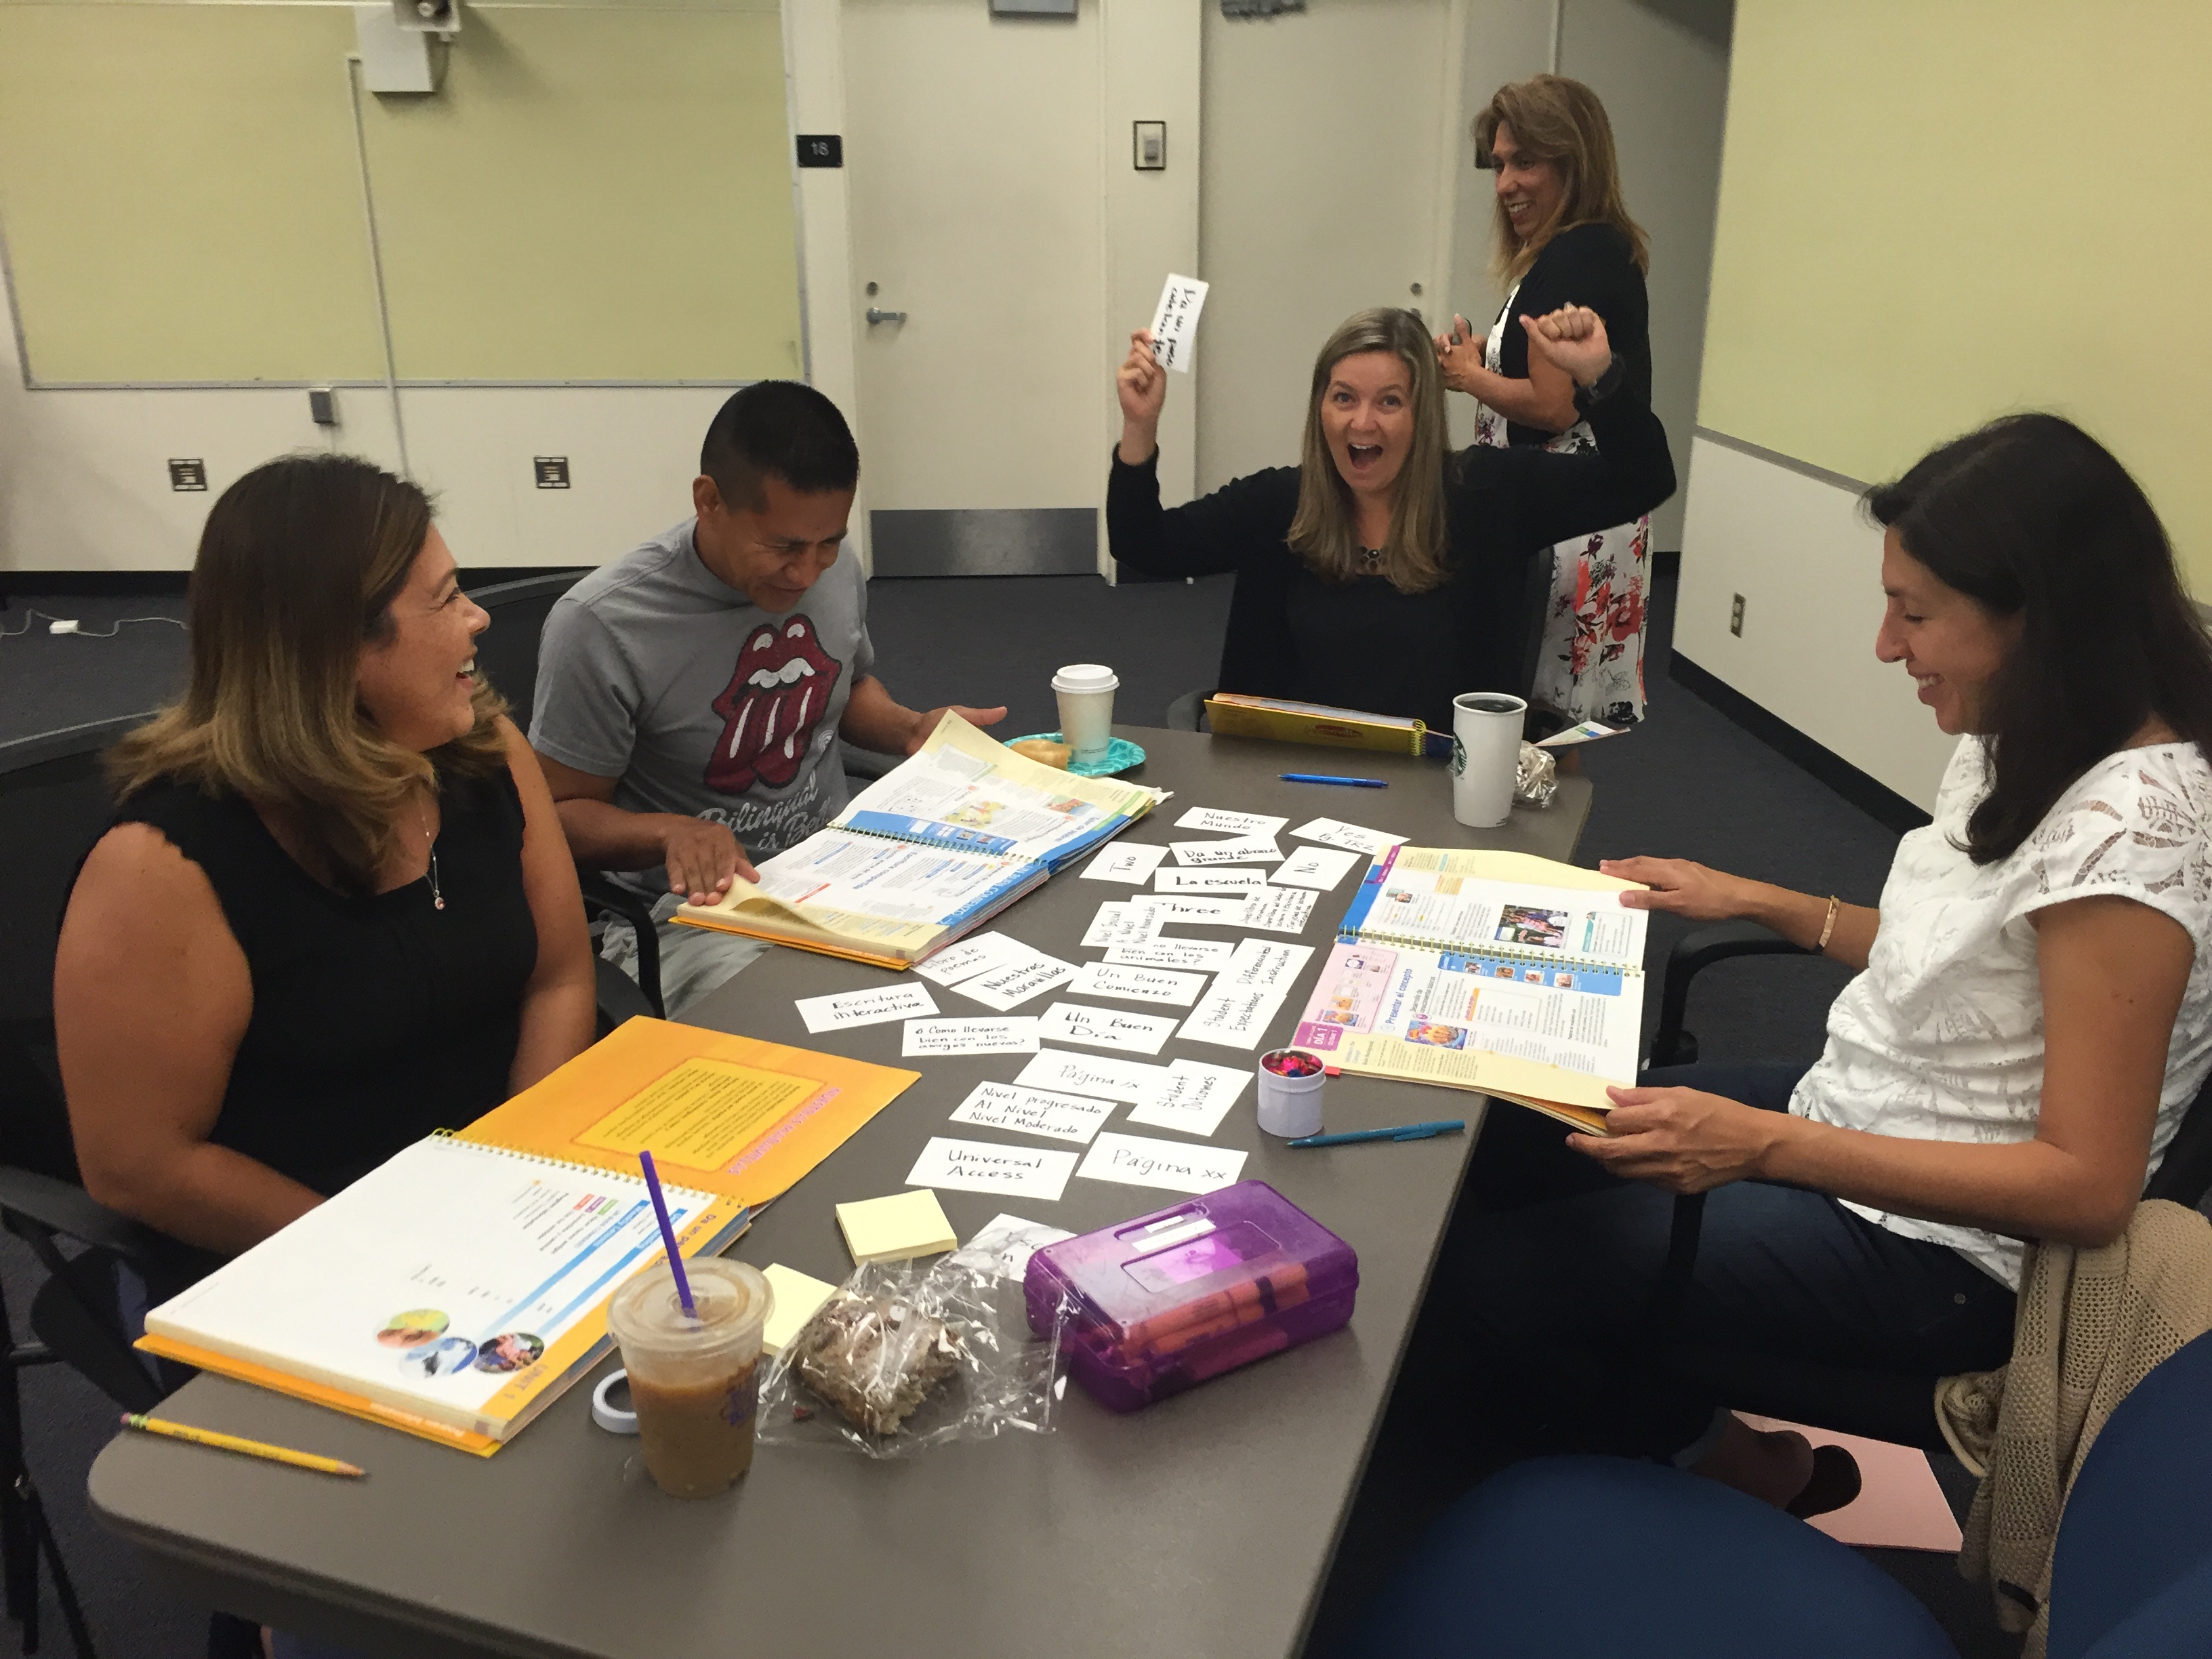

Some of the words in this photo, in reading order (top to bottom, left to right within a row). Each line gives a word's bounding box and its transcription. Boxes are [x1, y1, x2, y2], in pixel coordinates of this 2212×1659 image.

[811, 141, 829, 157] 18
[1200, 820, 1250, 830] Mundo
[1204, 812, 1266, 825] Nuestro
[1334, 825, 1366, 839] Yes
[757, 832, 779, 850] is
[1183, 850, 1205, 859] Da
[1216, 850, 1234, 858] un
[1191, 855, 1248, 864] grande
[1109, 856, 1136, 872] Two
[1294, 861, 1319, 874] No
[1176, 876, 1197, 886] La
[1204, 876, 1262, 886] escuela
[1153, 902, 1221, 914] Three
[1174, 943, 1218, 953] llevarse
[922, 956, 956, 970] Libro
[961, 947, 979, 956] de
[1261, 949, 1291, 985] Instruction
[1097, 968, 1120, 979] Un
[1134, 974, 1179, 986] Buen
[1092, 981, 1172, 996] Comienzo
[1385, 998, 1403, 1025] Presentar
[1399, 968, 1414, 991] concepto
[832, 991, 914, 1010] Escritura
[1203, 998, 1236, 1027] Student
[1229, 991, 1264, 1031] Expectations
[963, 1025, 1010, 1033] llevarse
[1065, 1012, 1090, 1024] Un
[1109, 1017, 1153, 1031] Buen
[918, 1042, 966, 1050] amigos
[1313, 1033, 1326, 1045] DÍA
[1058, 1064, 1115, 1086] Página
[1156, 1075, 1190, 1108] Student
[1181, 1076, 1217, 1111] Outcomes
[981, 1087, 1017, 1101] Nivel
[1026, 1095, 1102, 1115] progresado
[1004, 1105, 1047, 1118] Nivel
[968, 1111, 1006, 1124] Nivel
[1013, 1117, 1078, 1134] Moderado
[948, 1149, 1043, 1169] Universal
[1111, 1148, 1191, 1176] Página
[1201, 1168, 1228, 1180] xx
[947, 1165, 1025, 1180] Access
[701, 1214, 717, 1224] Da
